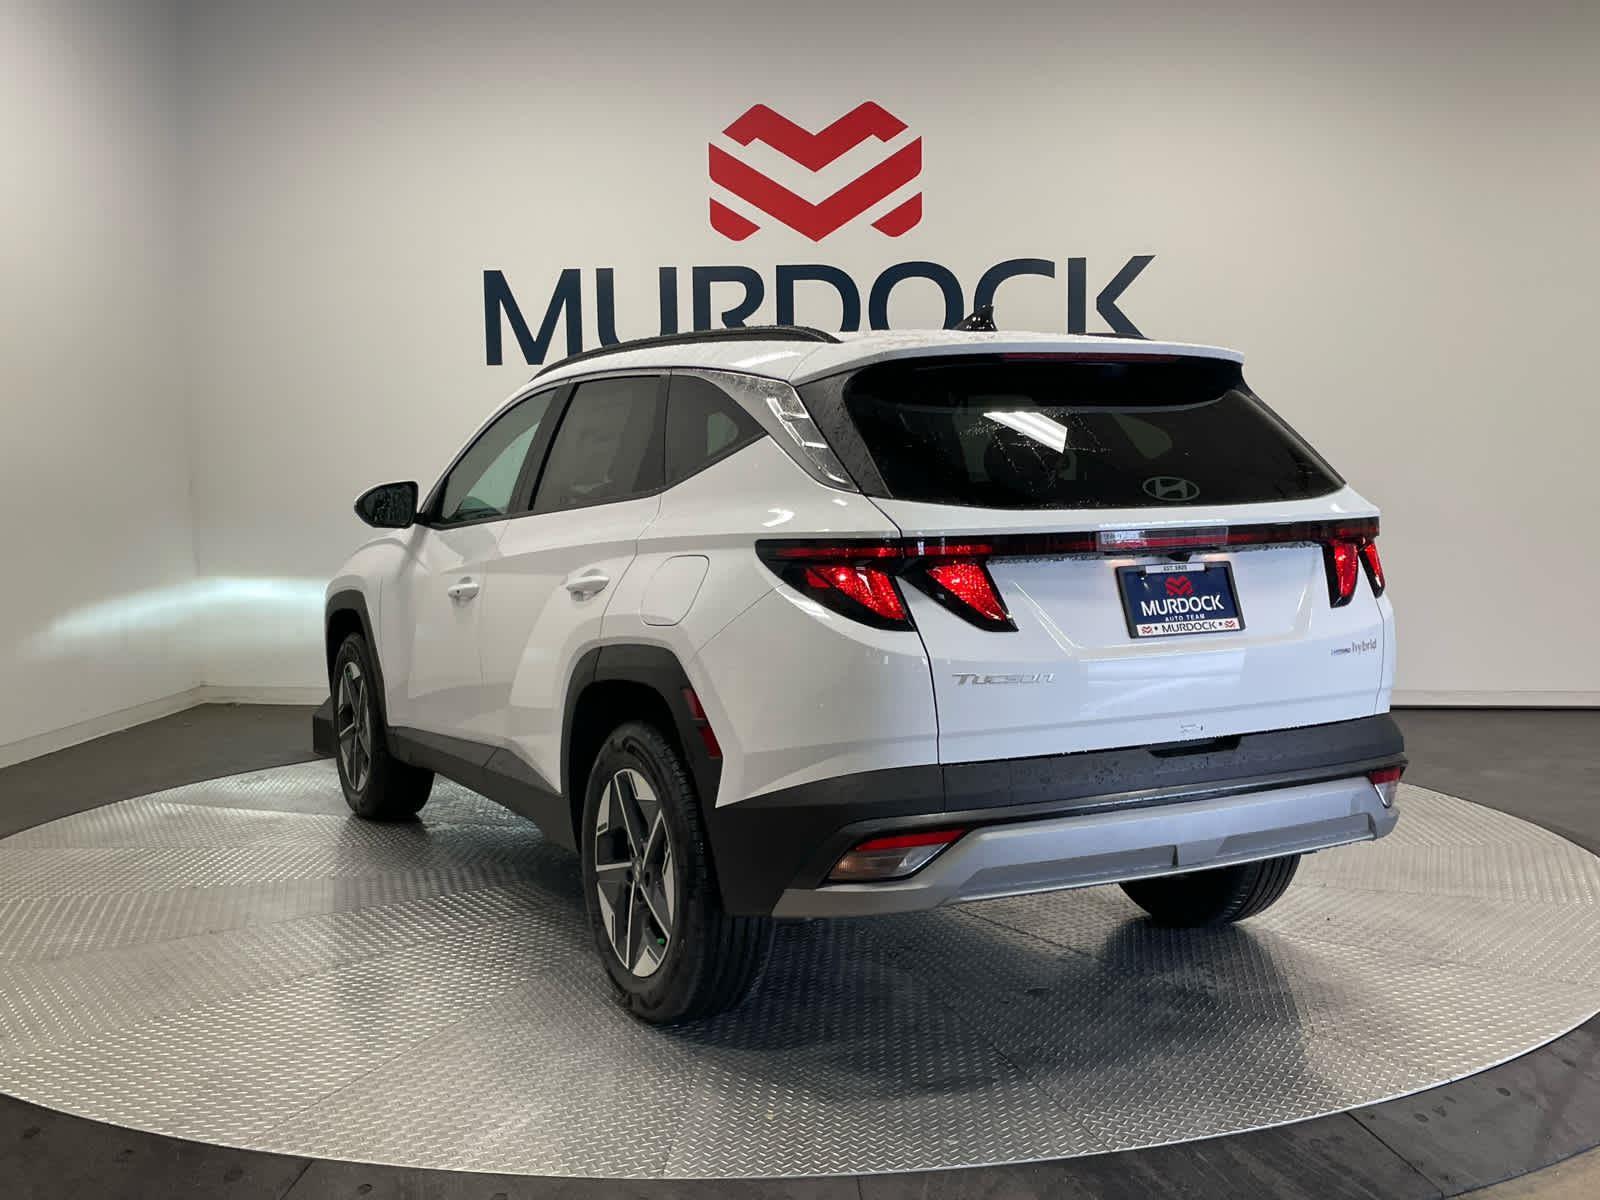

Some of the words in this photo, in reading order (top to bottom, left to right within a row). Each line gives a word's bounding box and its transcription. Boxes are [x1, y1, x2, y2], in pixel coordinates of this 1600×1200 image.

[483, 255, 1156, 366] MURDOCK
[1141, 595, 1224, 616] MURDOCK
[1186, 613, 1206, 621] TEAM
[1161, 621, 1217, 633] MURDOCK
[1352, 638, 1376, 655] hybrid
